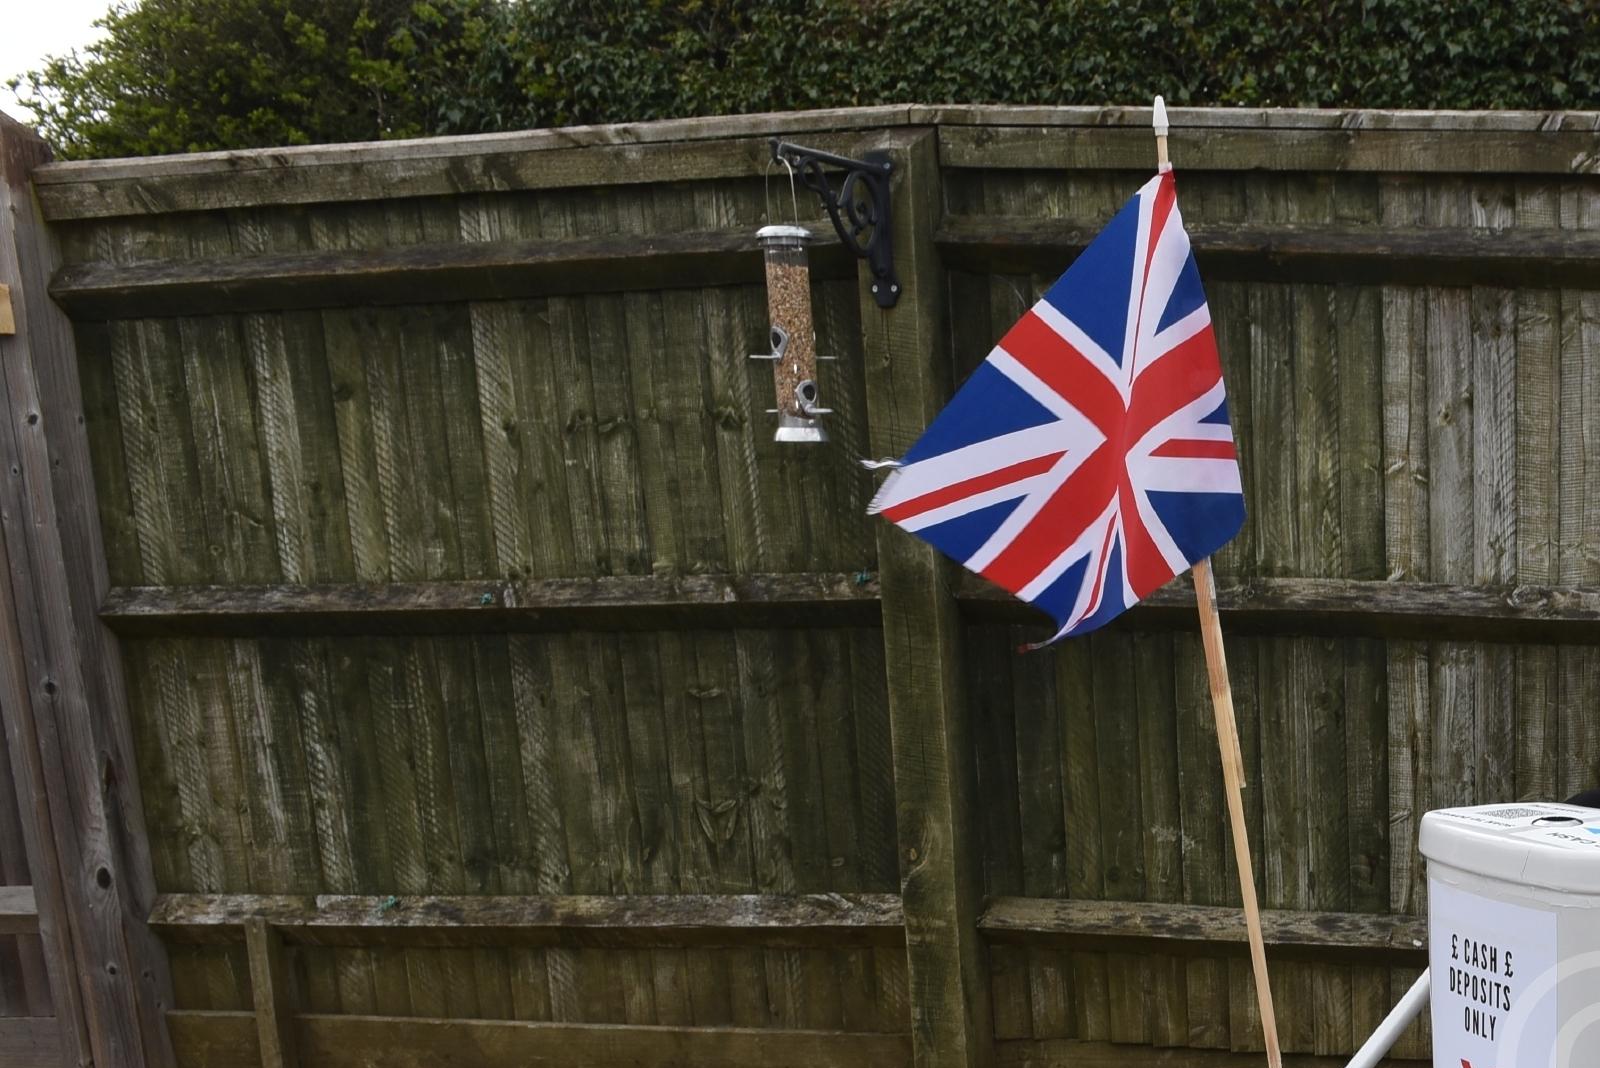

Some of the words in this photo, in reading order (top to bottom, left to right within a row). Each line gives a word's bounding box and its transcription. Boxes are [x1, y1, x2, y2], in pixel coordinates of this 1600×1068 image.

[1451, 933, 1459, 960] £
[1464, 938, 1497, 974] CASH
[1504, 951, 1514, 978] £
[1449, 966, 1511, 1012] DEPOSITS
[1464, 1006, 1496, 1042] ONLY
